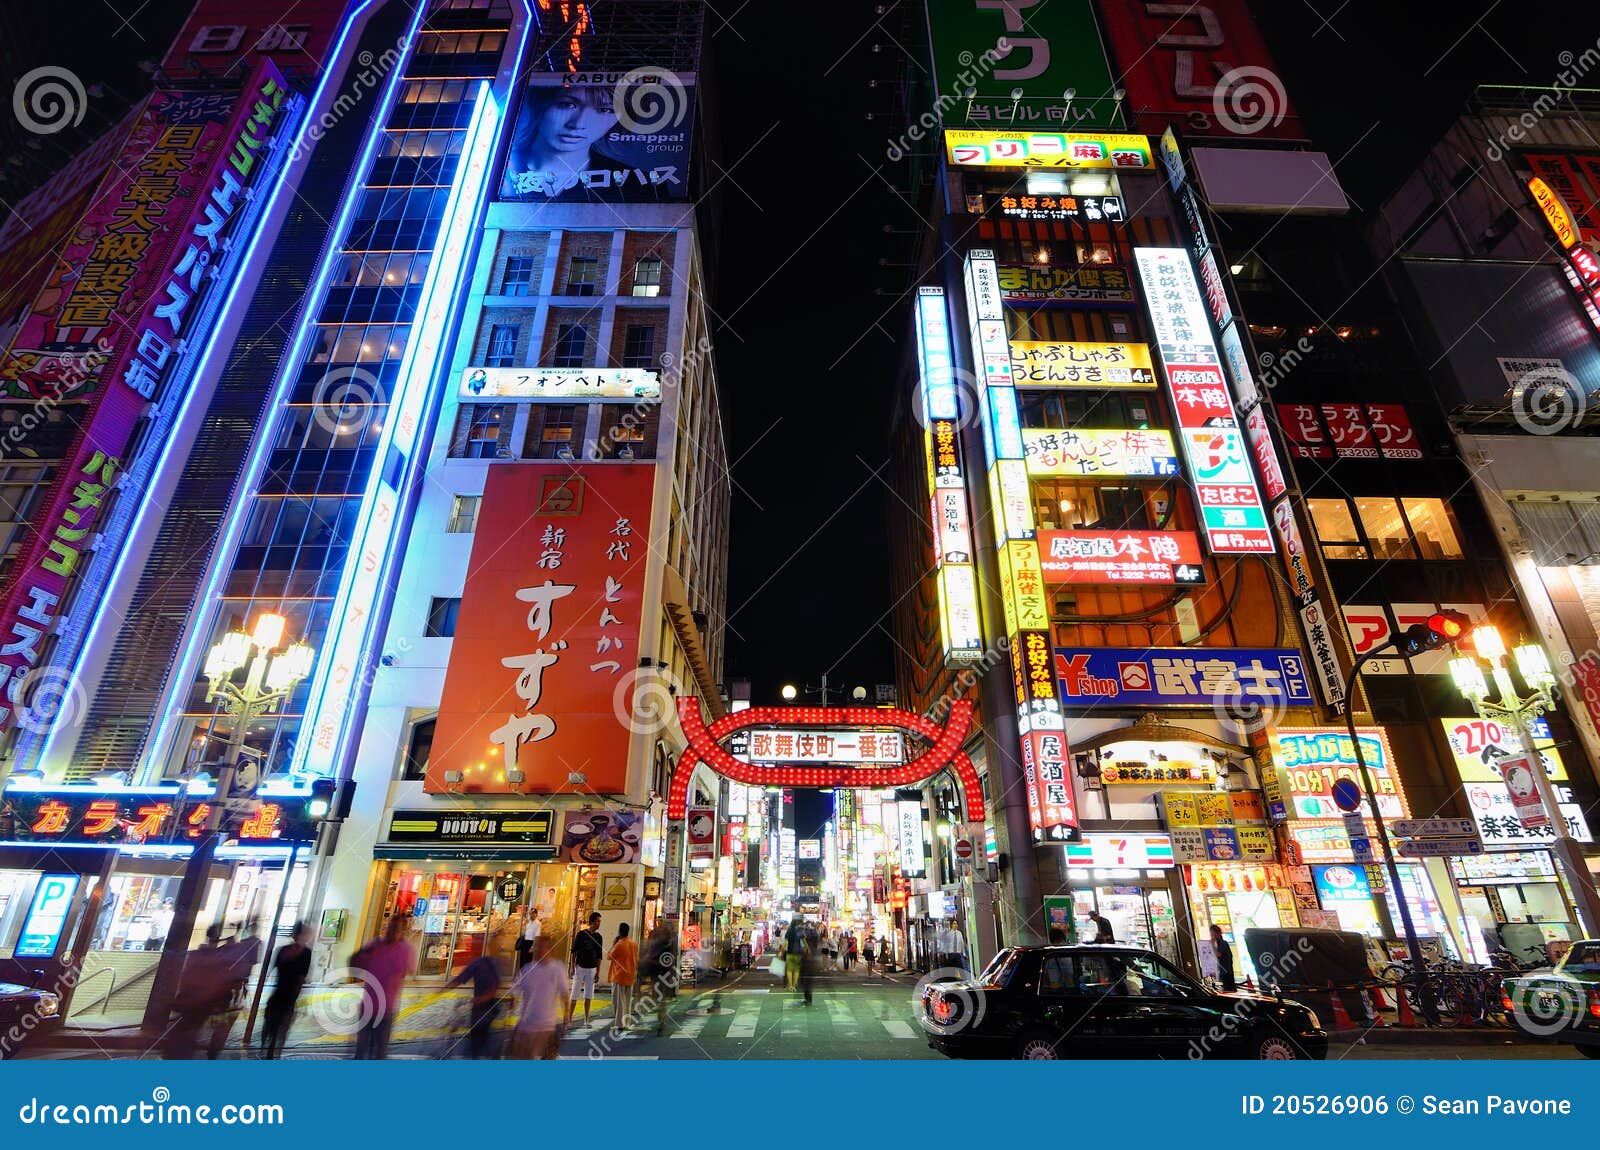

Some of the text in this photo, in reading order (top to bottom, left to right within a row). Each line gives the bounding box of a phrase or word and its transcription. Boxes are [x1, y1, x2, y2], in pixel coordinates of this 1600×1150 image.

[968, 104, 1097, 122] 当ビル向い
[608, 132, 685, 144] Smappa!
[646, 143, 684, 153] group
[954, 142, 1143, 167] フリー麻雀
[1000, 196, 1078, 210] お好み焼
[58, 125, 207, 328] 日本最大級設置
[152, 169, 243, 334] エスパス
[997, 266, 1126, 290] まんが喫茶
[517, 374, 607, 388] フォンベト
[1132, 368, 1152, 383] 4F
[1176, 386, 1229, 409] 本陣
[1209, 417, 1234, 428] 4F
[1294, 405, 1385, 420] カラオケ
[935, 420, 957, 467] お好み焼
[1023, 430, 1079, 457] お好み
[1299, 420, 1413, 443] ビックワン
[1040, 439, 1118, 467] もんじゃ
[1077, 452, 1118, 474] たこ
[1299, 446, 1321, 458] 5F
[1153, 457, 1176, 475] 7F
[1201, 487, 1257, 503] たばこ
[945, 494, 960, 533] 居酒屋
[1221, 509, 1248, 526] 酒
[1275, 504, 1298, 556] 270
[536, 524, 567, 569] 新宿
[1050, 534, 1181, 561] 居酒屋 本陣
[1015, 542, 1039, 596] フリー麻雀
[1175, 564, 1200, 581] 4F
[589, 516, 633, 675] 名代 とんかつ
[1021, 596, 1045, 621] さん
[488, 579, 577, 771] すずや
[1026, 633, 1054, 698] お好み焼
[1151, 657, 1305, 697] 武富士 3F
[1371, 660, 1391, 673] 3F
[752, 734, 899, 759] 歌舞伎町一番街
[1455, 721, 1501, 756] 270
[1039, 735, 1069, 805] 居酒屋
[441, 818, 497, 834] DOUTOR
[1173, 808, 1192, 820] さん
[1050, 824, 1074, 840] 4F
[39, 882, 66, 911] P
